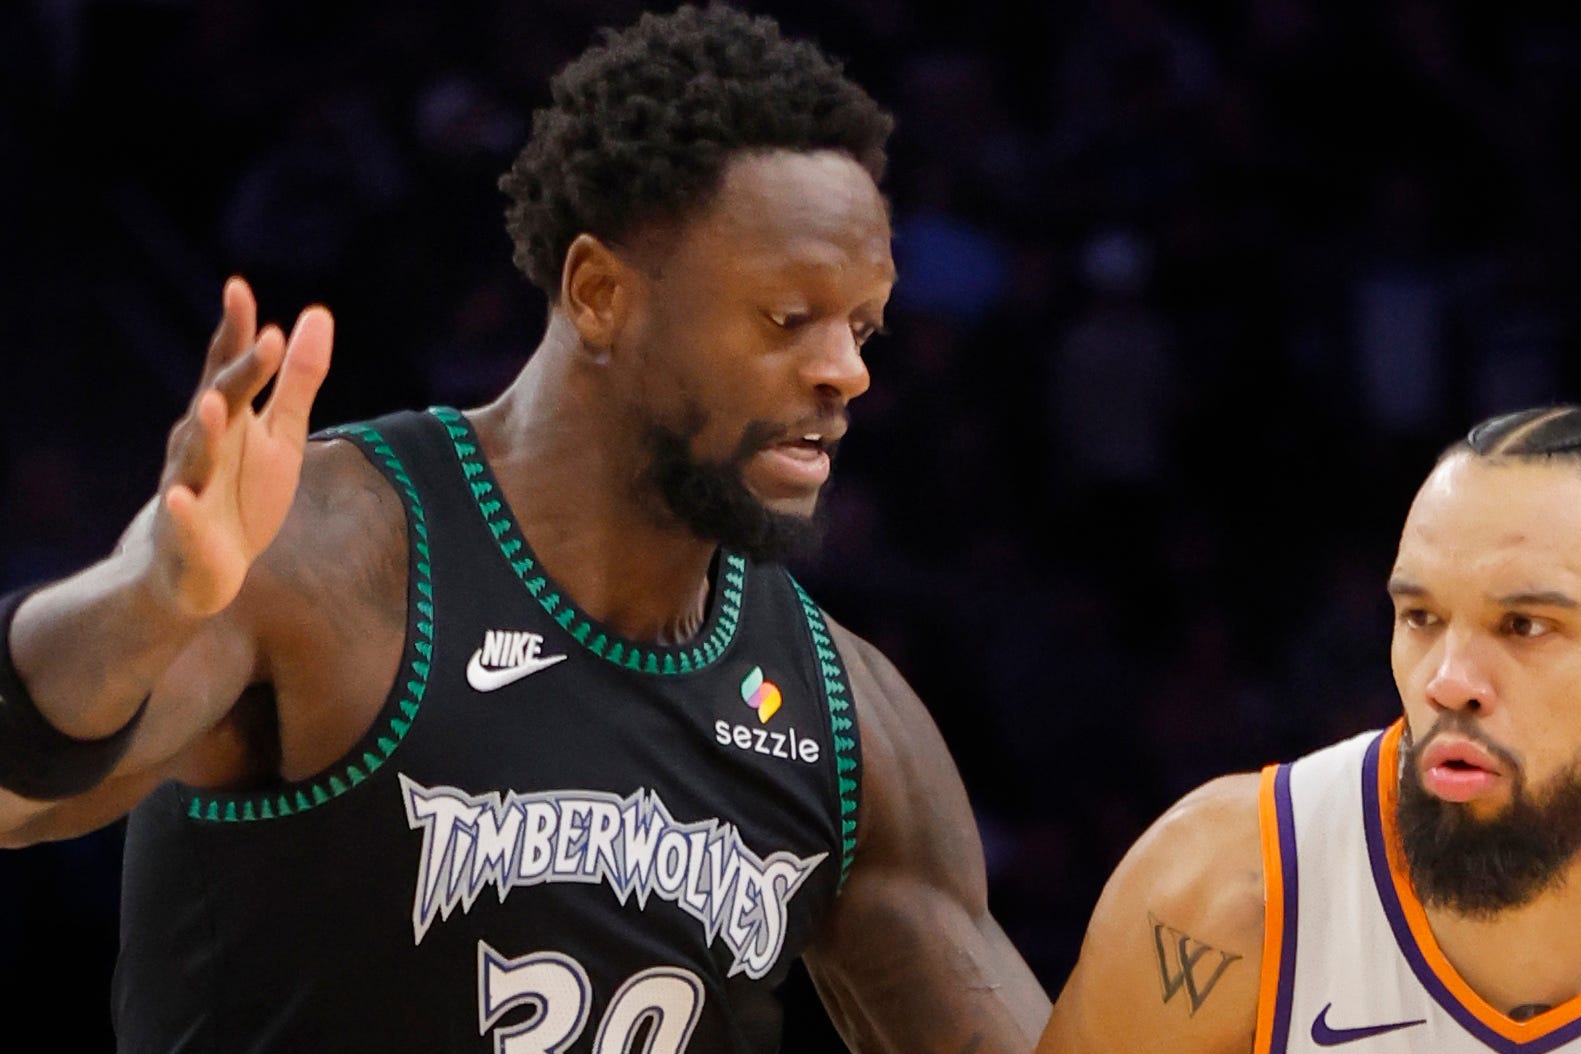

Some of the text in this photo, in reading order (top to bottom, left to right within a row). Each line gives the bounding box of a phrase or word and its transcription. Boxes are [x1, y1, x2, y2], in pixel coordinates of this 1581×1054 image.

[480, 629, 544, 667] NIKE
[715, 718, 820, 763] sezzle
[398, 773, 829, 979] TIMBERWOLVES
